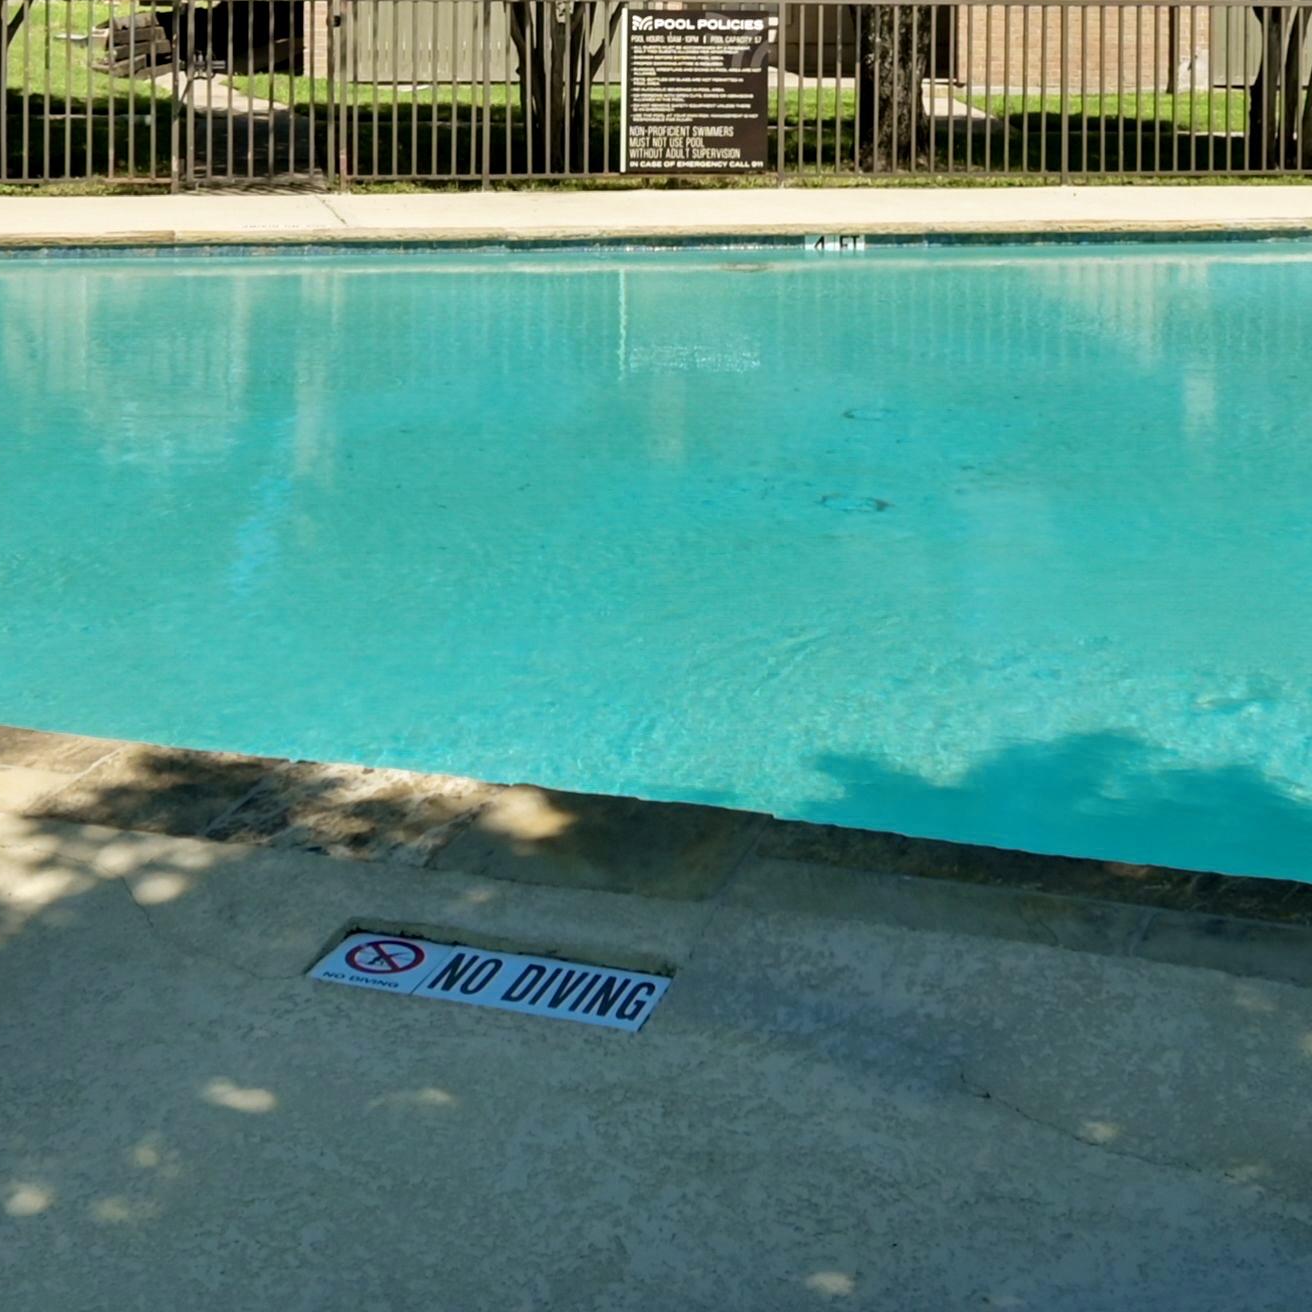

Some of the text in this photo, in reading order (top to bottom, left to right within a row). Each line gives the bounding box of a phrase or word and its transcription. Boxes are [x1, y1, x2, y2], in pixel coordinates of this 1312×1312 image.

[654, 19, 764, 30] POOL POLICIES
[629, 125, 734, 137] NON-PROFICIENT SWIMMERS
[629, 137, 705, 147] MUST NOT USE POOL
[629, 148, 741, 159] WITHOUT ADULT SUPERVISION
[322, 971, 399, 988] NO DIVING
[428, 952, 656, 1021] NO DIVING
